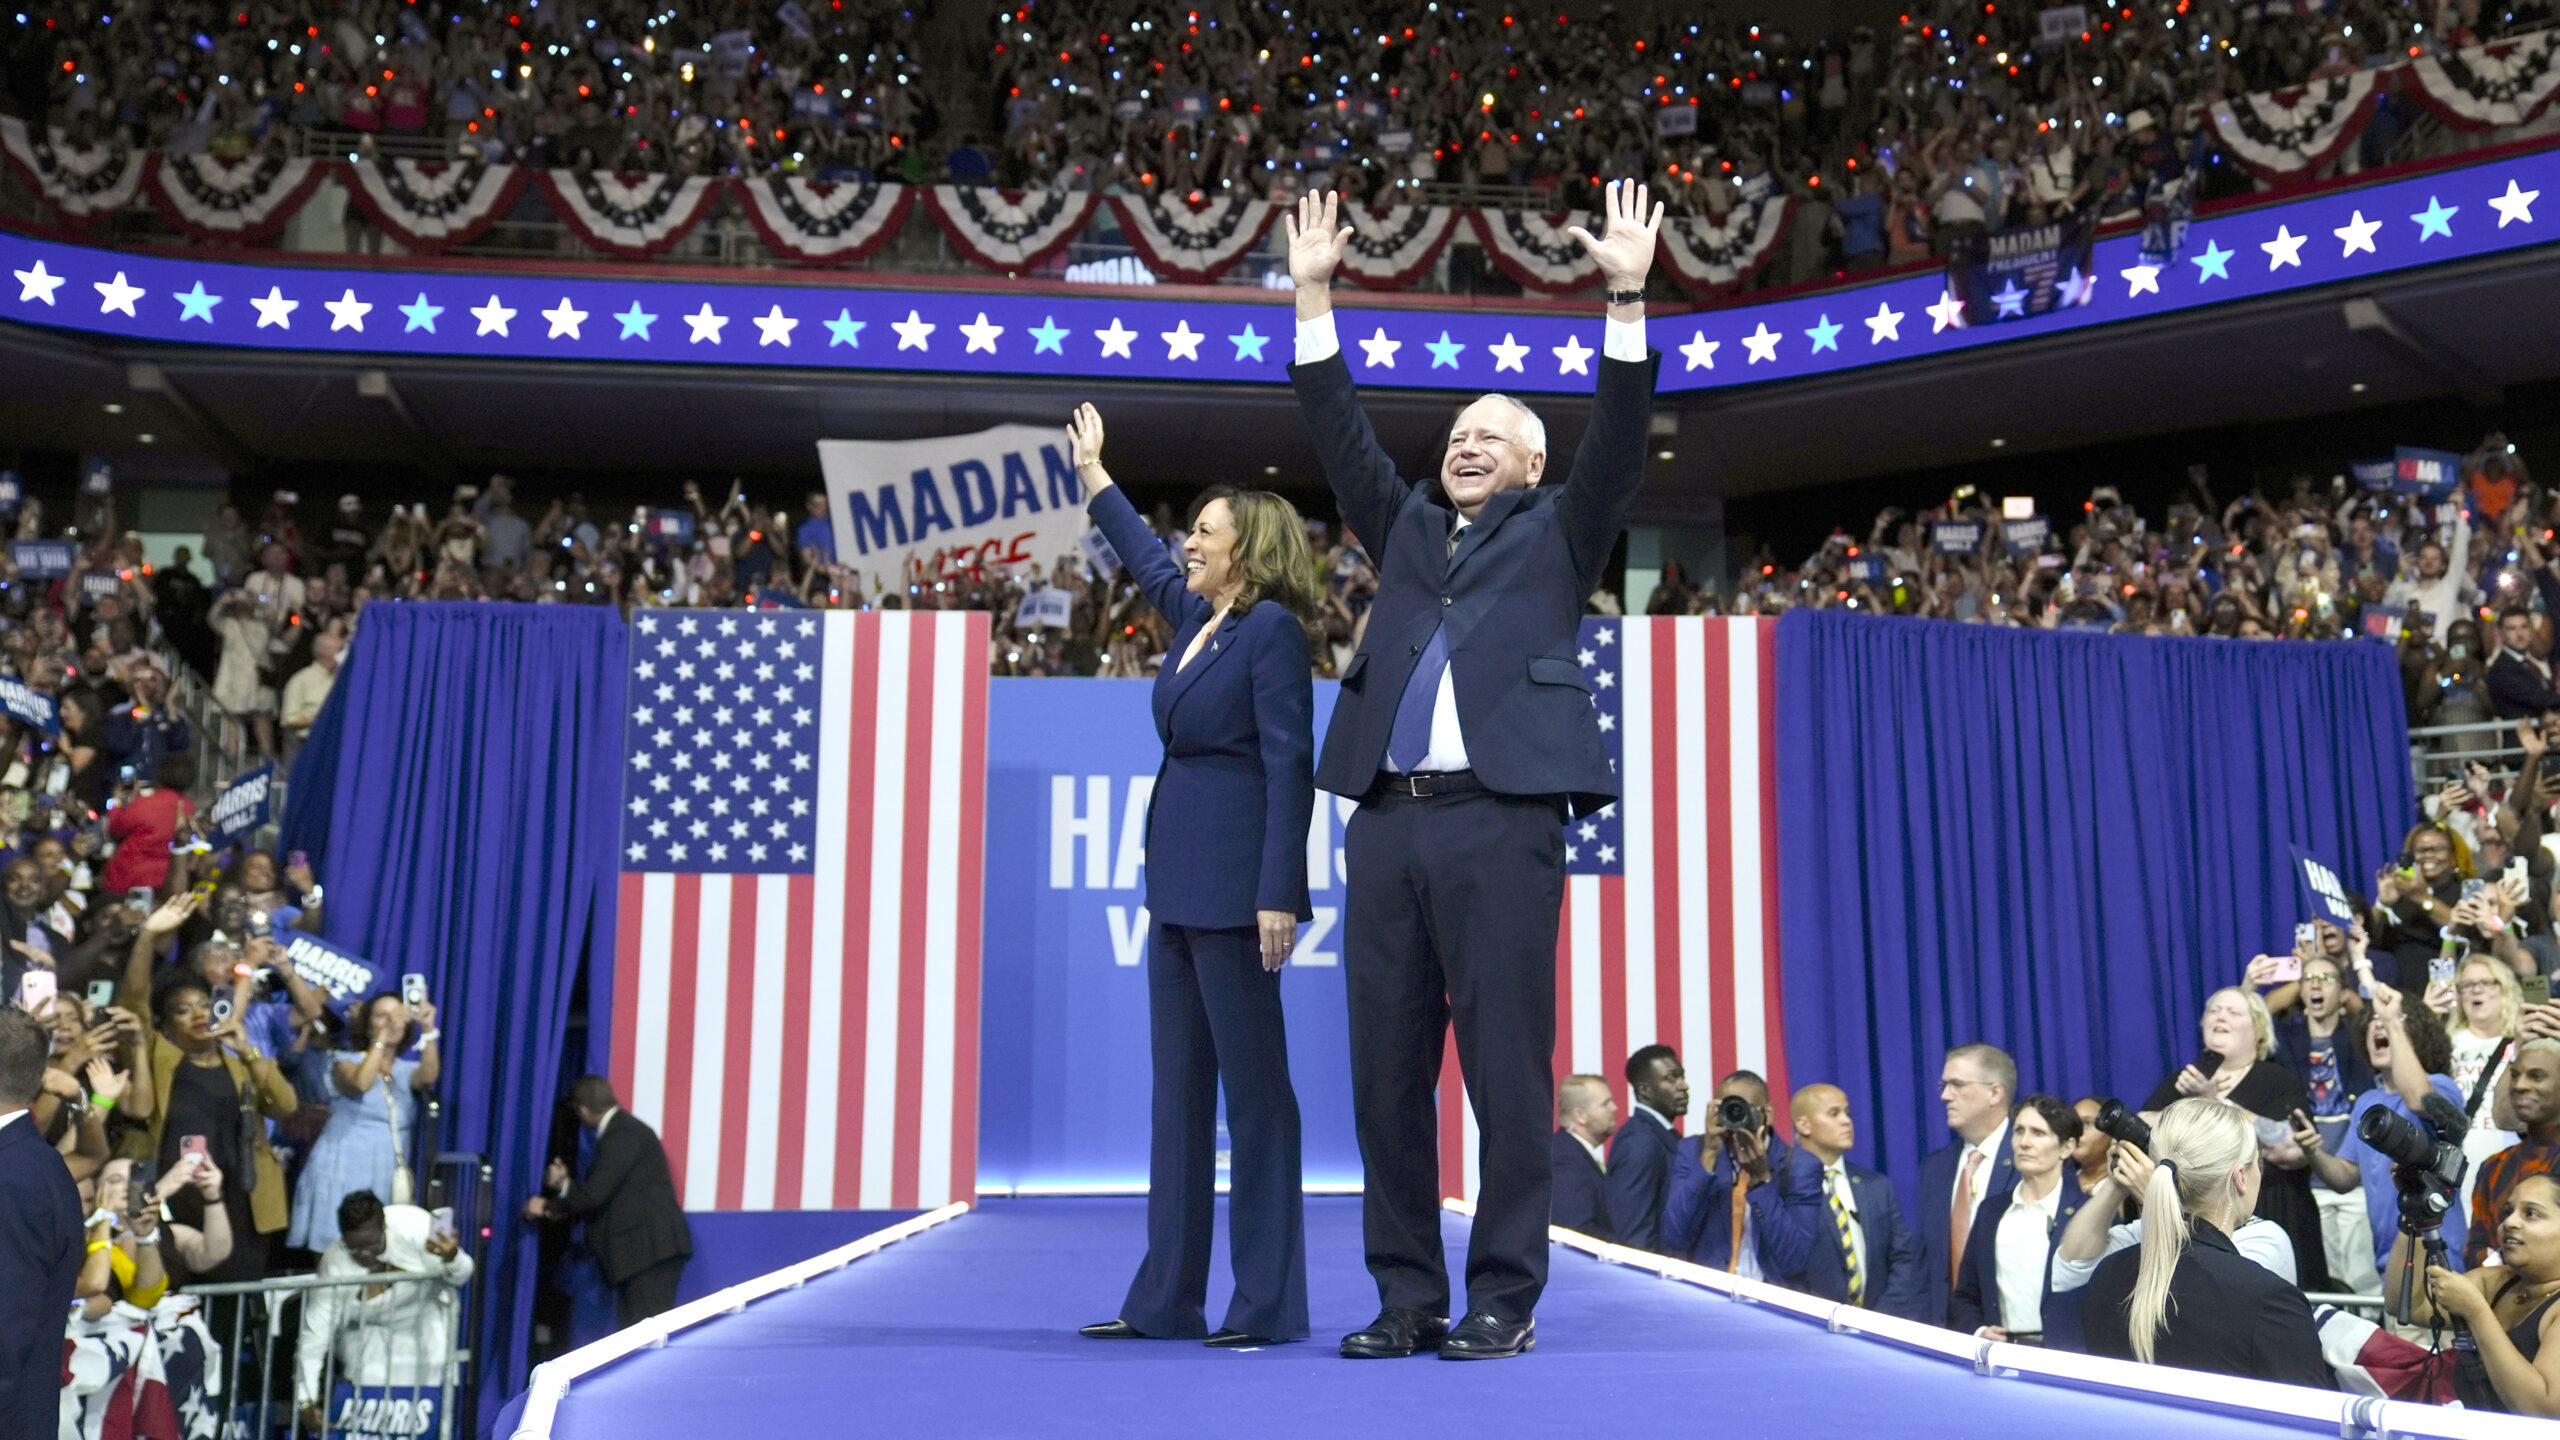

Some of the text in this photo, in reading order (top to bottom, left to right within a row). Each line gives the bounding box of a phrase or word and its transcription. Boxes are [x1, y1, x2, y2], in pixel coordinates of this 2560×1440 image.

[1989, 223, 2060, 256] MADAM
[1936, 525, 1978, 542] HARRIS
[2007, 520, 2047, 543] HARRIS
[211, 773, 269, 824] HARRIS
[221, 803, 258, 835] WALZ
[287, 937, 372, 994] HARRIS
